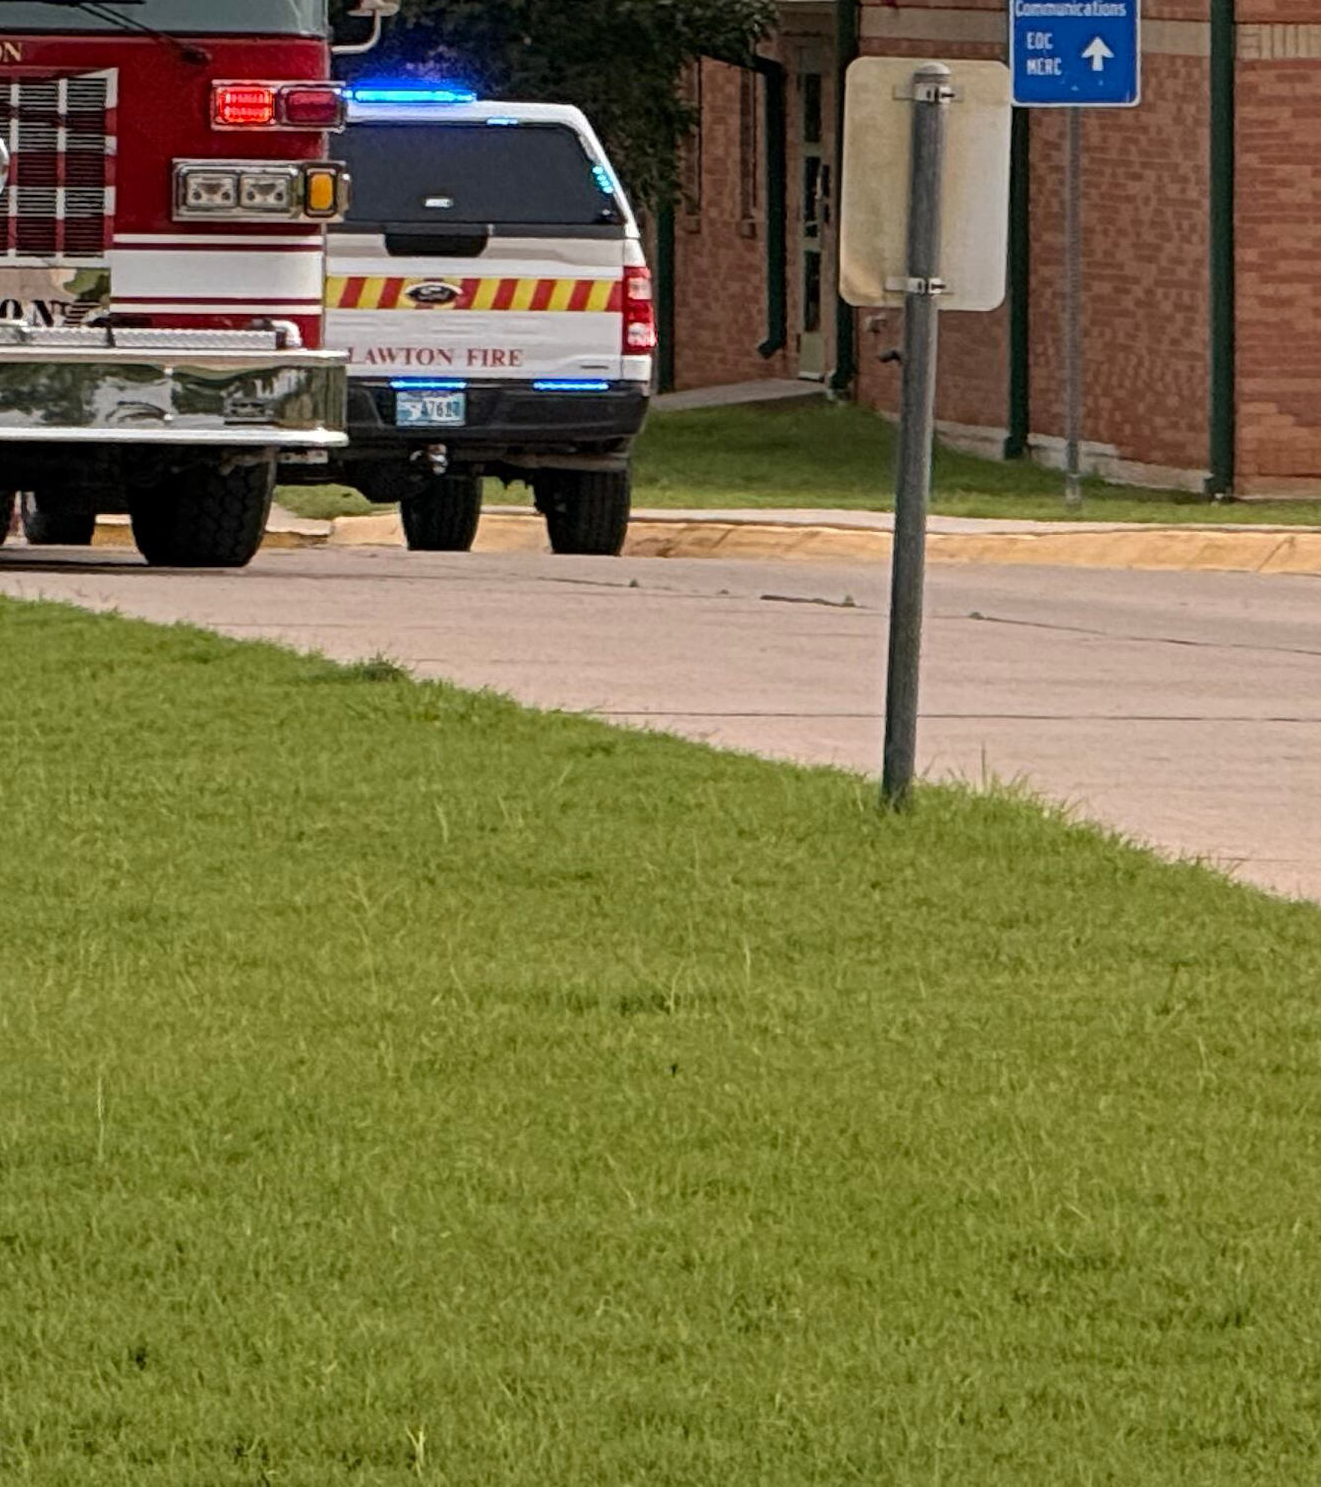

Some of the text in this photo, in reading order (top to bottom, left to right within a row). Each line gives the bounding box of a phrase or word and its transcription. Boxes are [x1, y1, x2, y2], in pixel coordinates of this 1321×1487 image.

[1015, 0, 1127, 17] Communications
[1026, 31, 1054, 50] EOC
[1026, 57, 1063, 75] MERC
[348, 346, 524, 367] LAWTON FIRE
